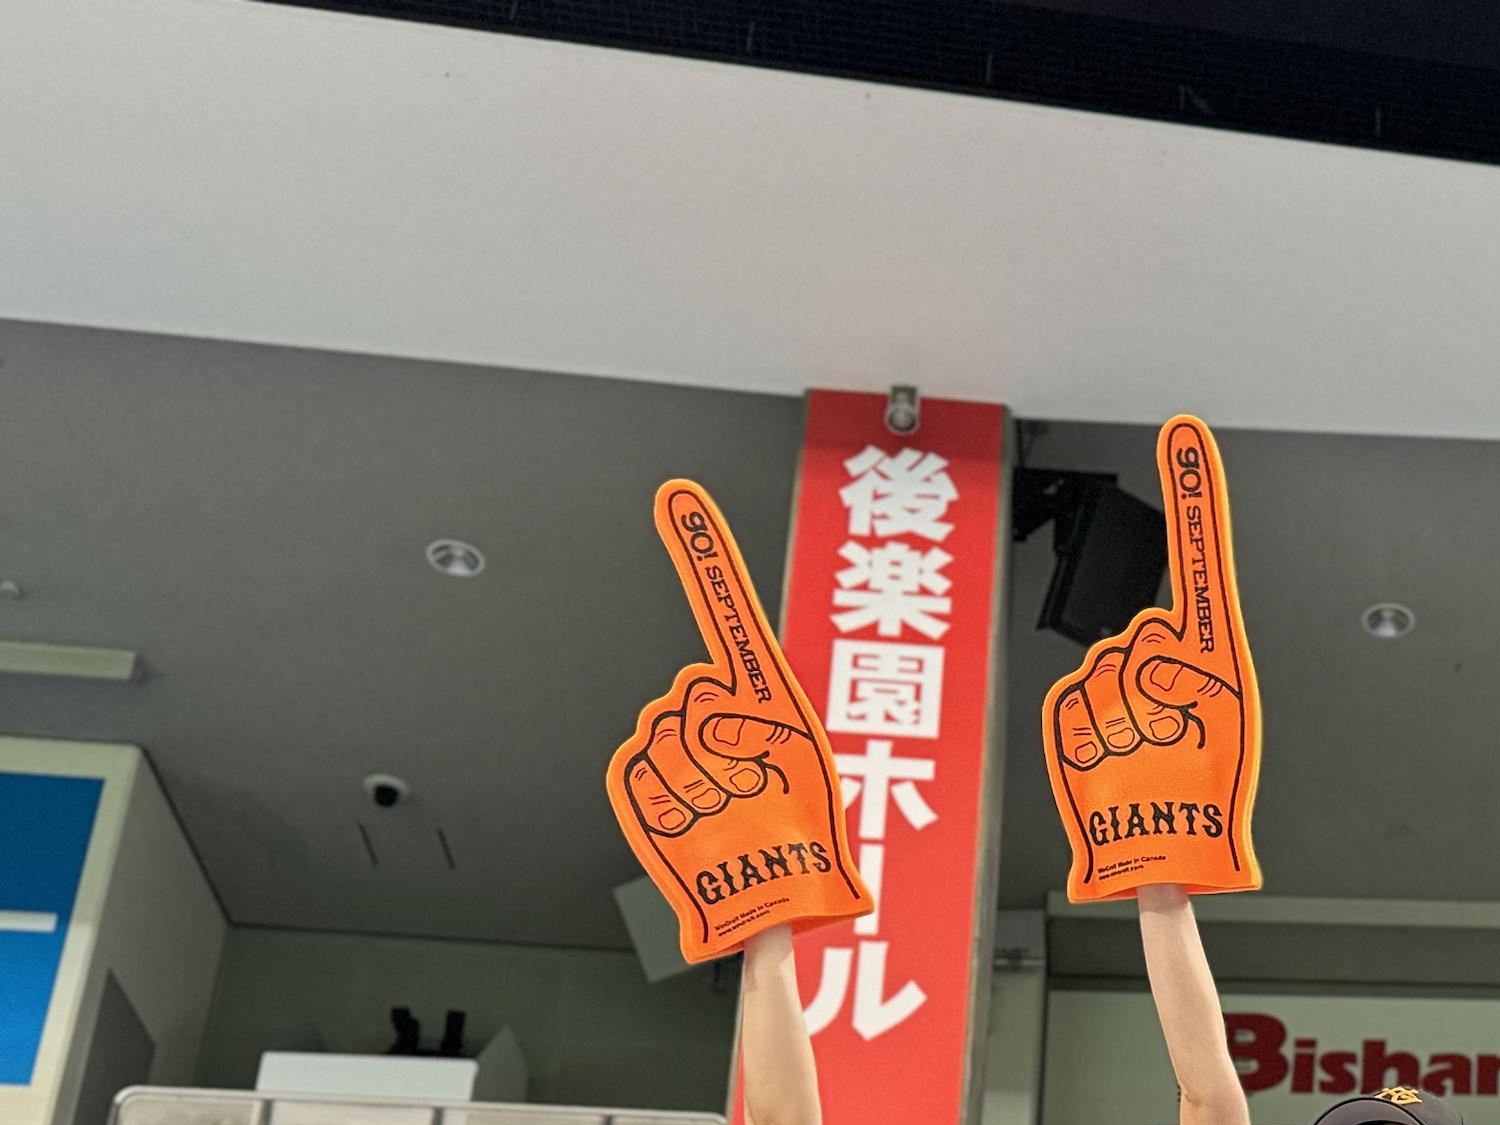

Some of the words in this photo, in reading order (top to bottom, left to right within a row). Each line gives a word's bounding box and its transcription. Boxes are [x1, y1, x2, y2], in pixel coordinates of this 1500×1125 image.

[705, 564, 772, 705] SEPTEMBER
[1188, 505, 1215, 654] SEPTEMBER
[804, 445, 960, 1041] 後楽園ホール
[695, 841, 834, 905] GIANTS
[1088, 801, 1224, 847] GIANTS
